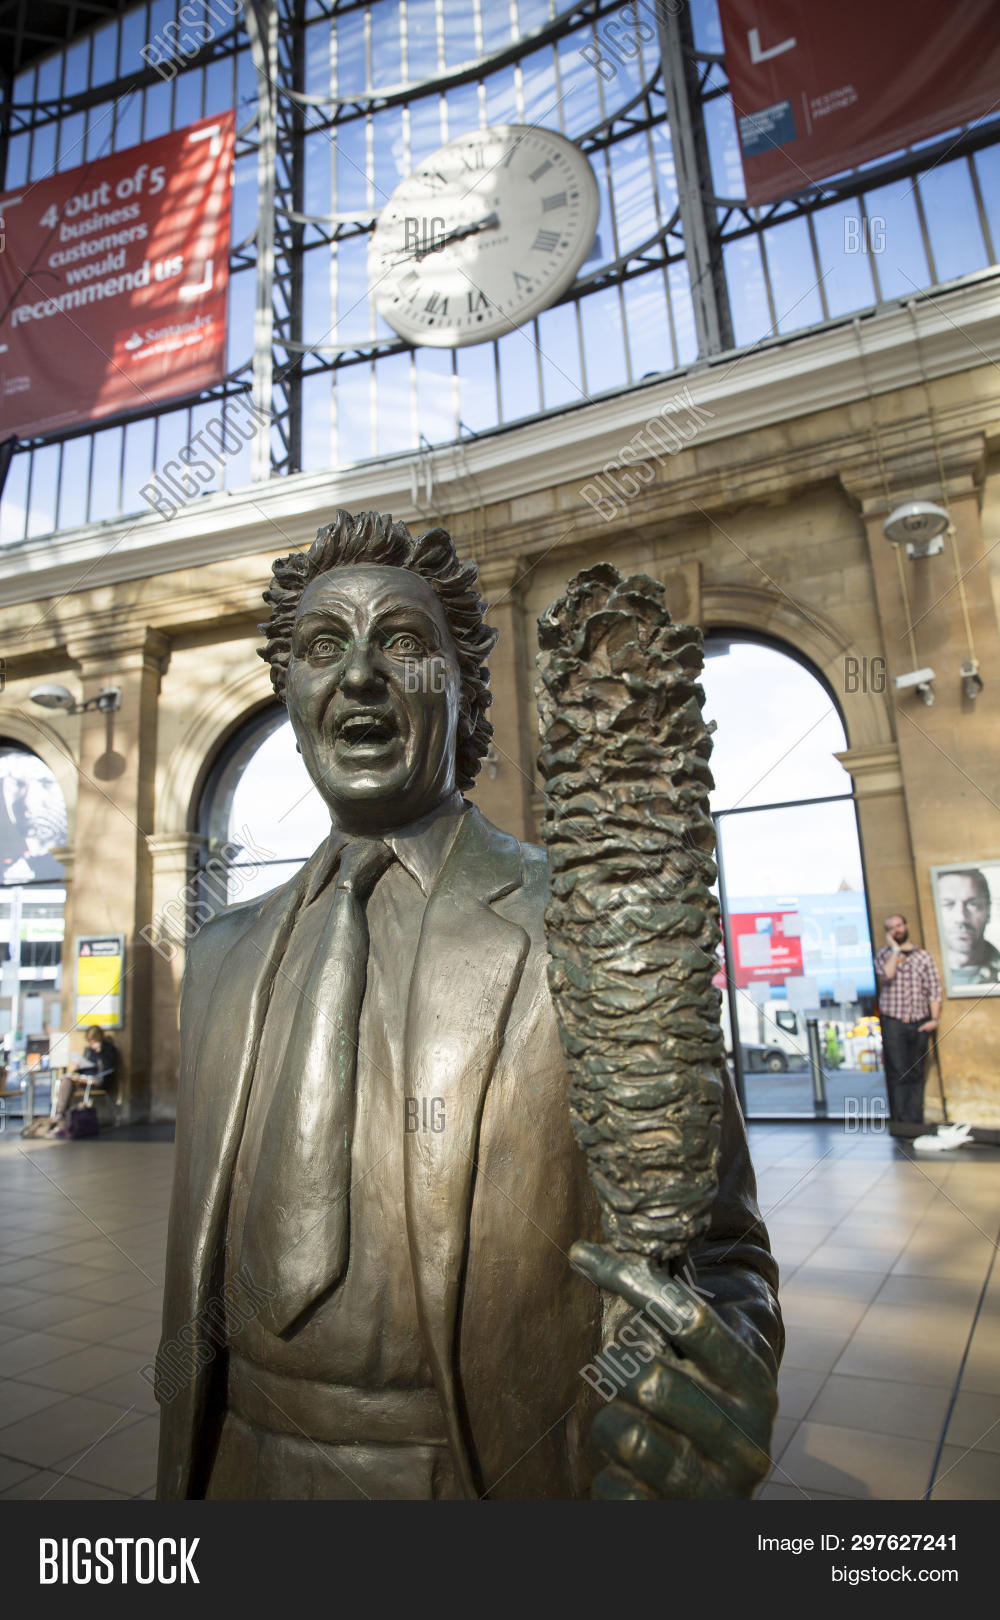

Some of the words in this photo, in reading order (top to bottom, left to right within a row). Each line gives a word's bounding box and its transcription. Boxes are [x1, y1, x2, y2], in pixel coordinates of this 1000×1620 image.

[39, 204, 60, 230] 4
[65, 182, 111, 217] out
[116, 164, 149, 199] of
[148, 165, 166, 196] 5
[60, 202, 141, 243] business
[48, 222, 149, 268] customers
[66, 248, 127, 286] would
[11, 260, 150, 328] recommend
[154, 255, 184, 282] us
[145, 313, 213, 344] Santander
